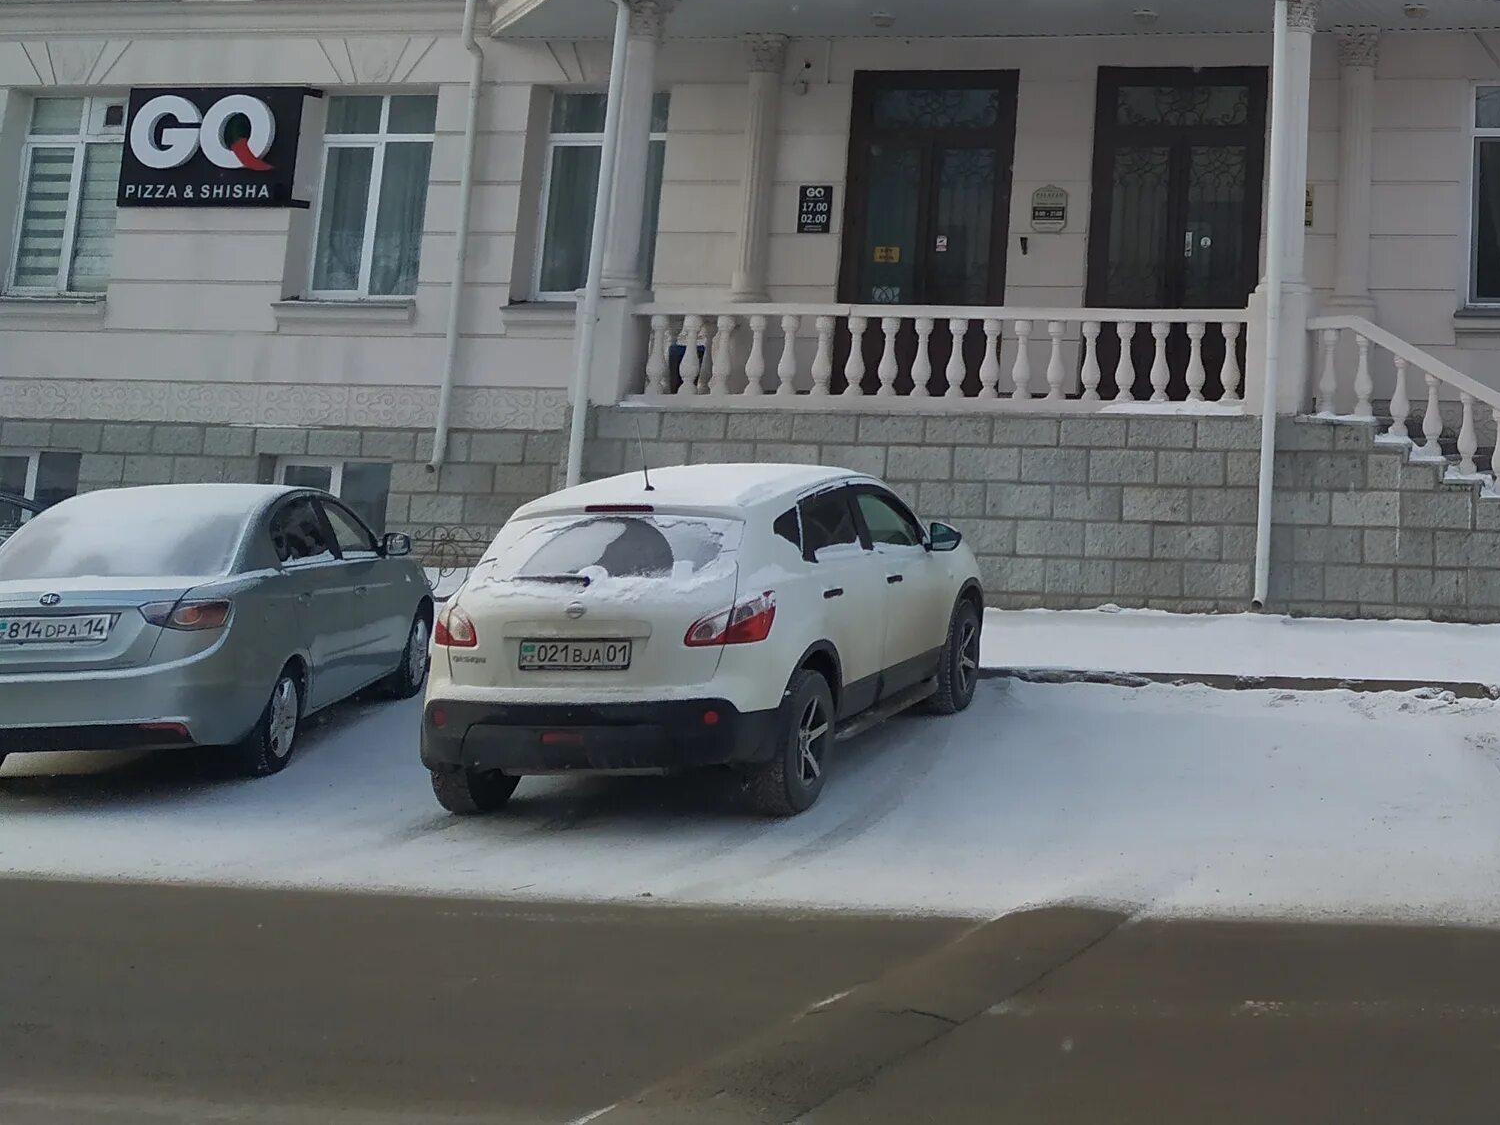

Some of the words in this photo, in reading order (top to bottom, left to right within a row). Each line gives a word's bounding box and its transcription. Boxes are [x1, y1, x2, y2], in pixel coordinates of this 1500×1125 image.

[130, 94, 276, 171] GQ
[125, 184, 177, 198] PIZZA
[183, 184, 194, 198] &
[200, 184, 270, 199] SHISHA
[802, 202, 828, 212] 17.00
[801, 213, 827, 223] 02.00
[84, 618, 105, 635] 14
[606, 644, 627, 662] 01
